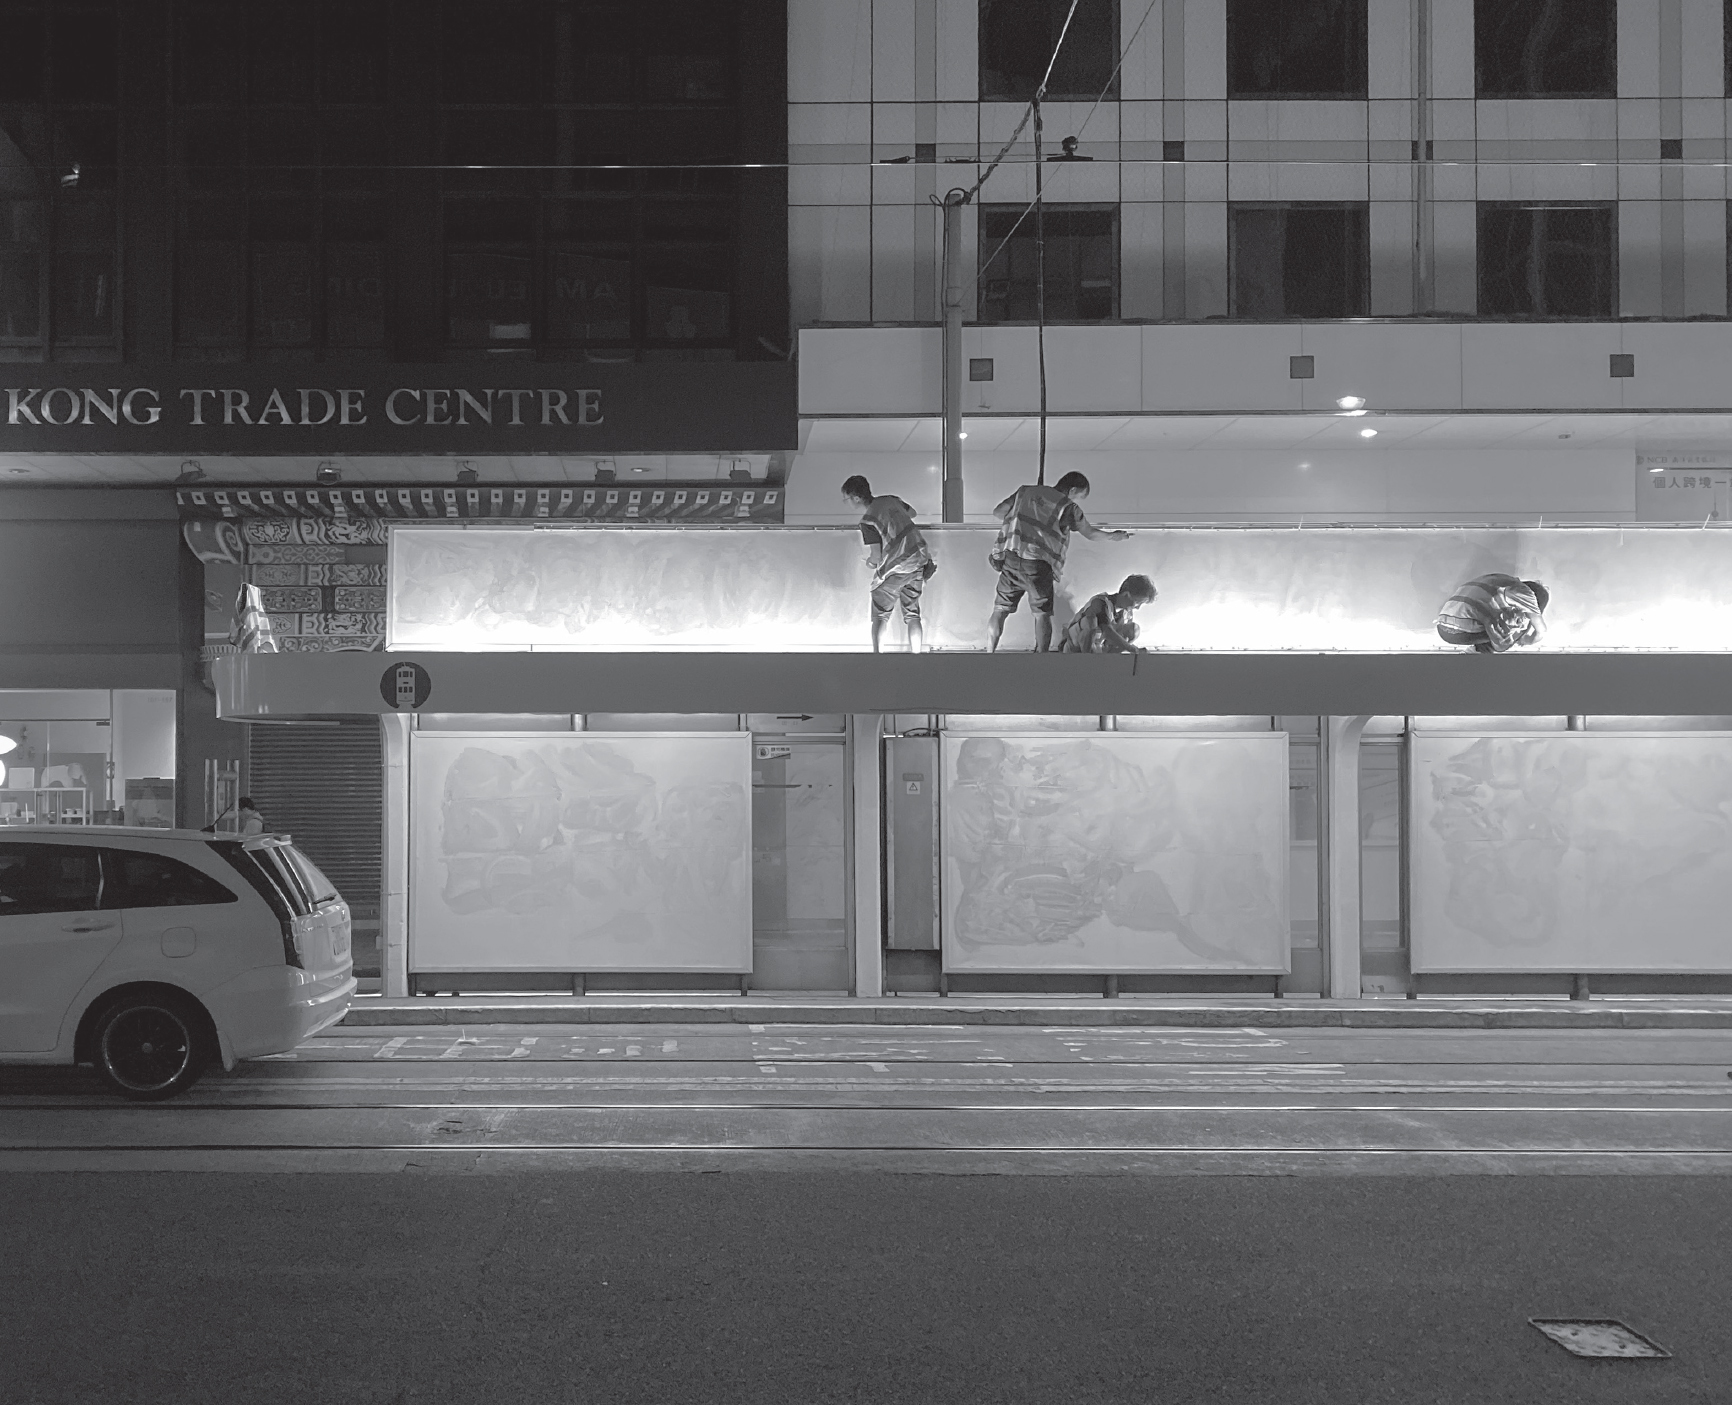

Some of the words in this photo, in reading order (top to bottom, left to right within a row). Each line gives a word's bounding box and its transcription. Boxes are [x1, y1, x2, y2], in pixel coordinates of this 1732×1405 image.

[5, 388, 161, 425] KONG
[179, 388, 367, 425] TRADE
[385, 388, 604, 425] CENTRE
[1647, 456, 1669, 464] NCB
[1653, 476, 1732, 489] 個人跨境一
